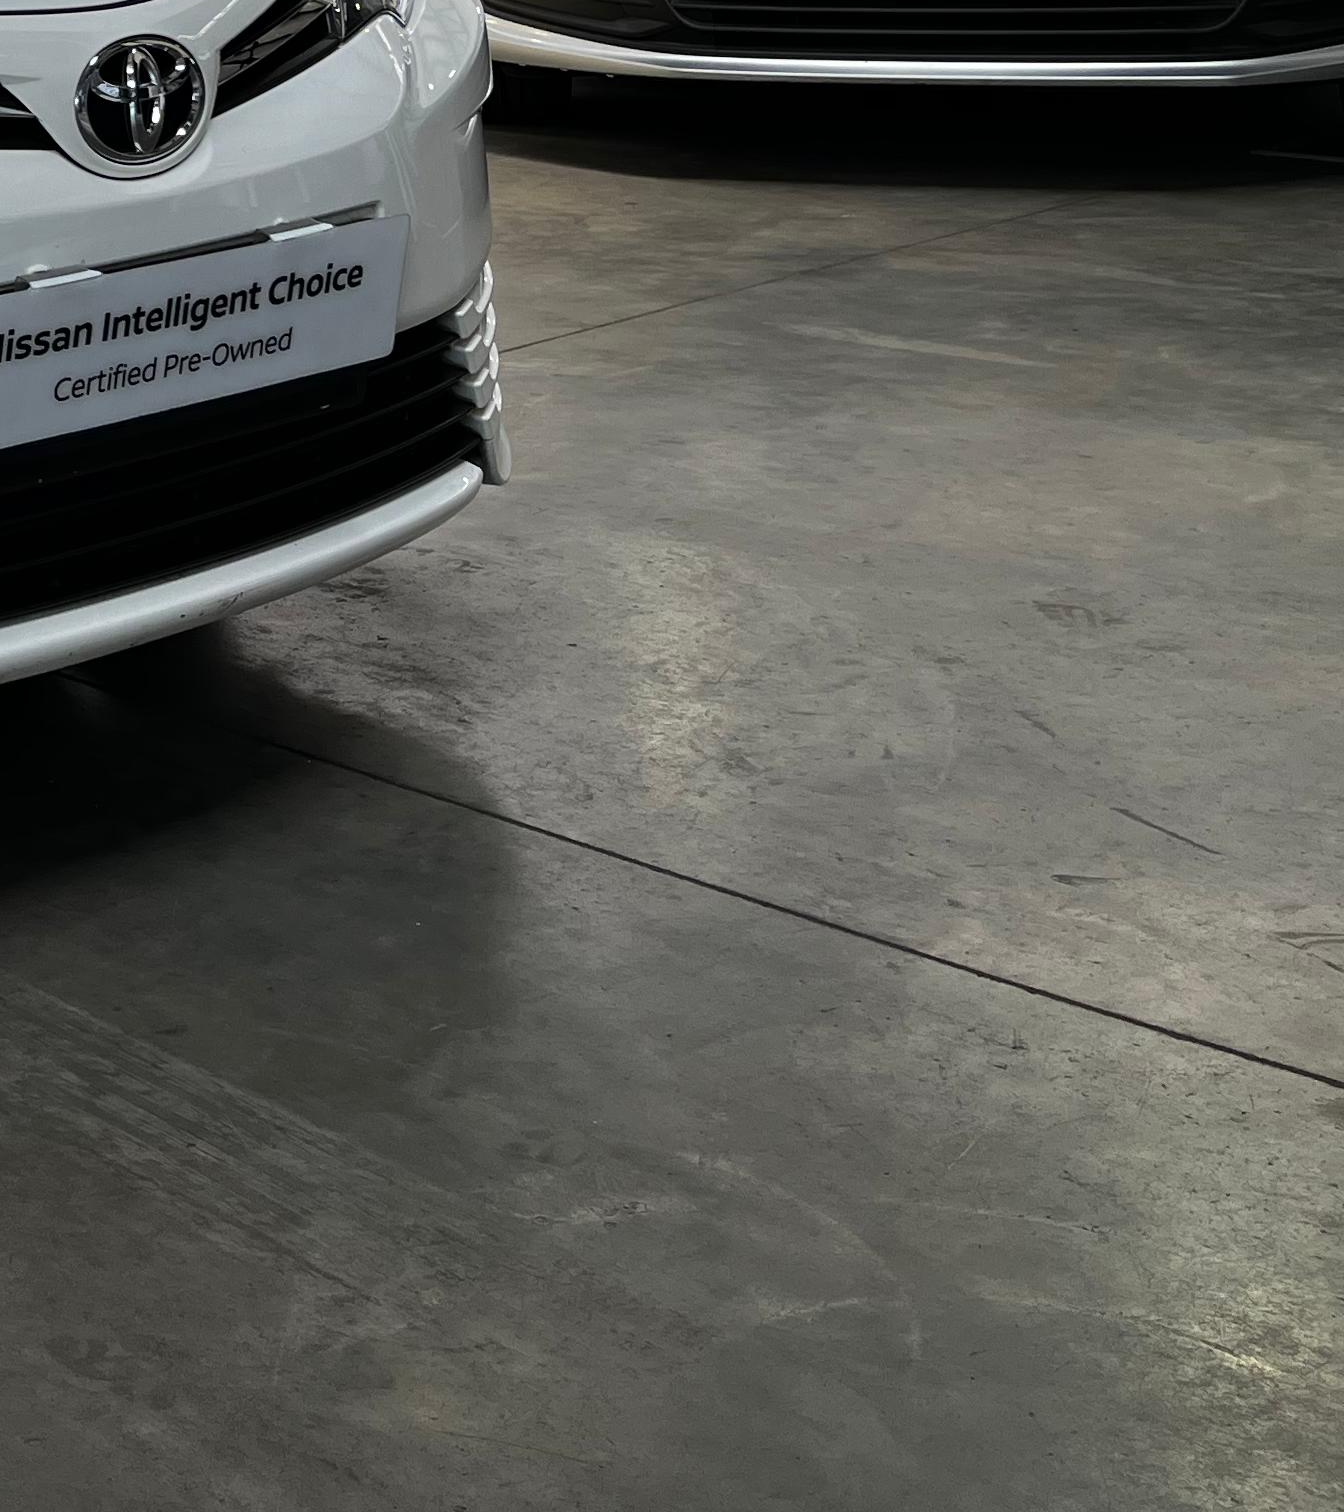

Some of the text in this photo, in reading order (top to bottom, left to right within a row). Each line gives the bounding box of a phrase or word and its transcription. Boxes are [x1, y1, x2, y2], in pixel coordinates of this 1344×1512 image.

[101, 282, 261, 342] Intelligent
[268, 261, 365, 305] Choice
[53, 327, 294, 402] Certified Pre-Owned
